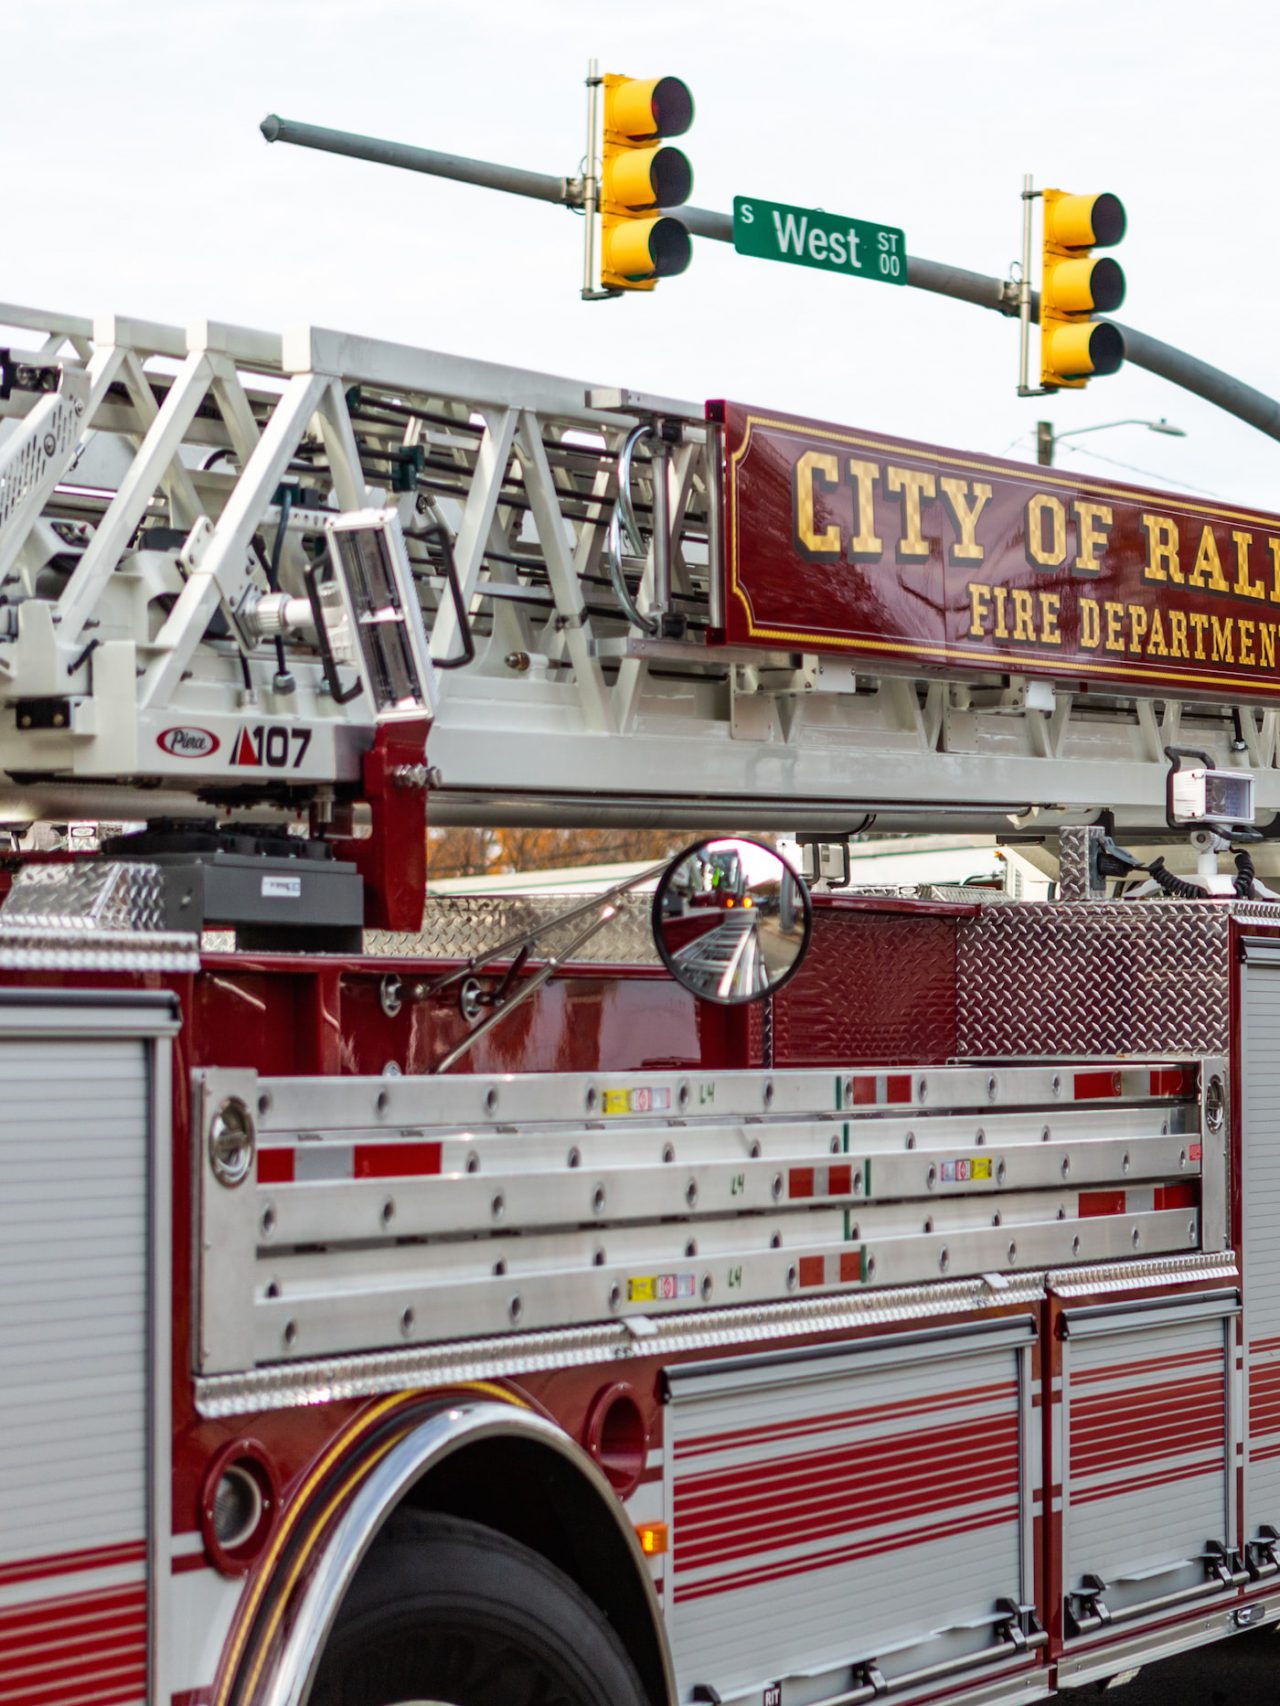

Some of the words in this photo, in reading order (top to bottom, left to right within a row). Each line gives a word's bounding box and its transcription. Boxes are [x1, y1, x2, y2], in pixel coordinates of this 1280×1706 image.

[740, 203, 755, 224] S
[771, 210, 862, 268] West
[877, 231, 899, 253] ST
[879, 253, 900, 276] 00
[794, 450, 993, 560] CITY
[1026, 492, 1113, 572] OF
[967, 582, 1062, 645] FIRE
[170, 729, 208, 751] Pierce
